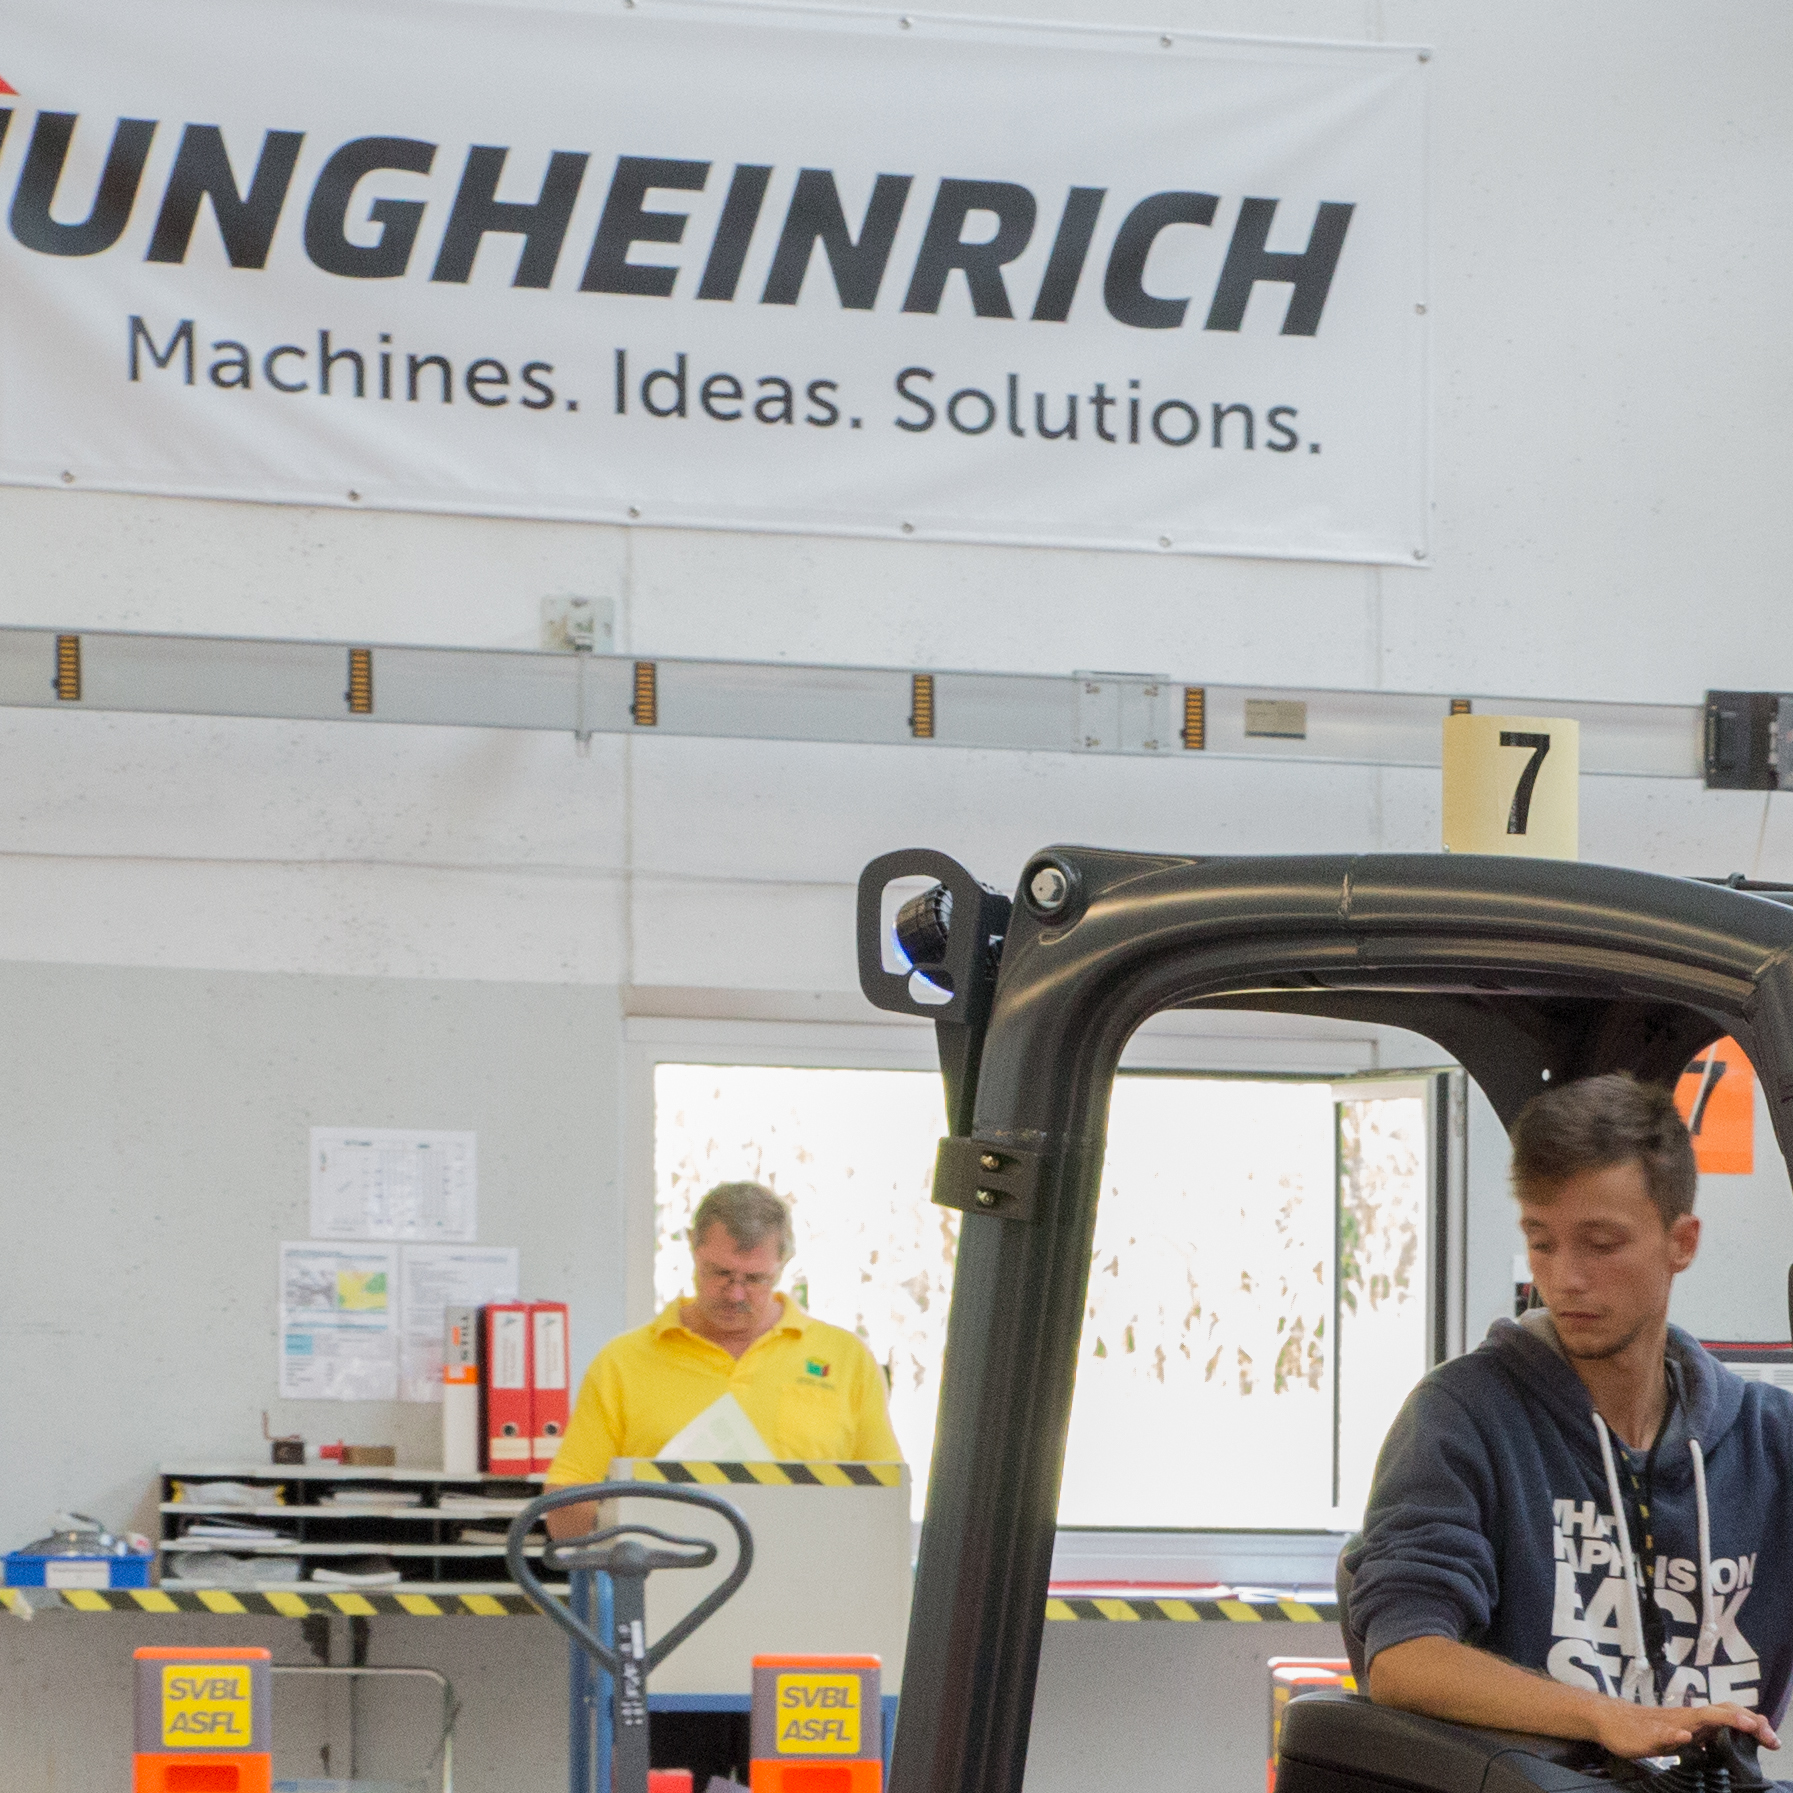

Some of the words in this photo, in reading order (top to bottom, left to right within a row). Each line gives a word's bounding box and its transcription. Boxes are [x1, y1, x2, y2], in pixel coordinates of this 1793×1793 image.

[125, 313, 581, 413] Machines.
[614, 348, 864, 430] Ideas.
[894, 366, 1323, 456] Solutions.
[1499, 731, 1551, 834] 7
[168, 1678, 246, 1703] SVBL
[781, 1685, 857, 1708] SVBL
[168, 1711, 241, 1734] ASFL
[781, 1719, 852, 1742] ASFL
